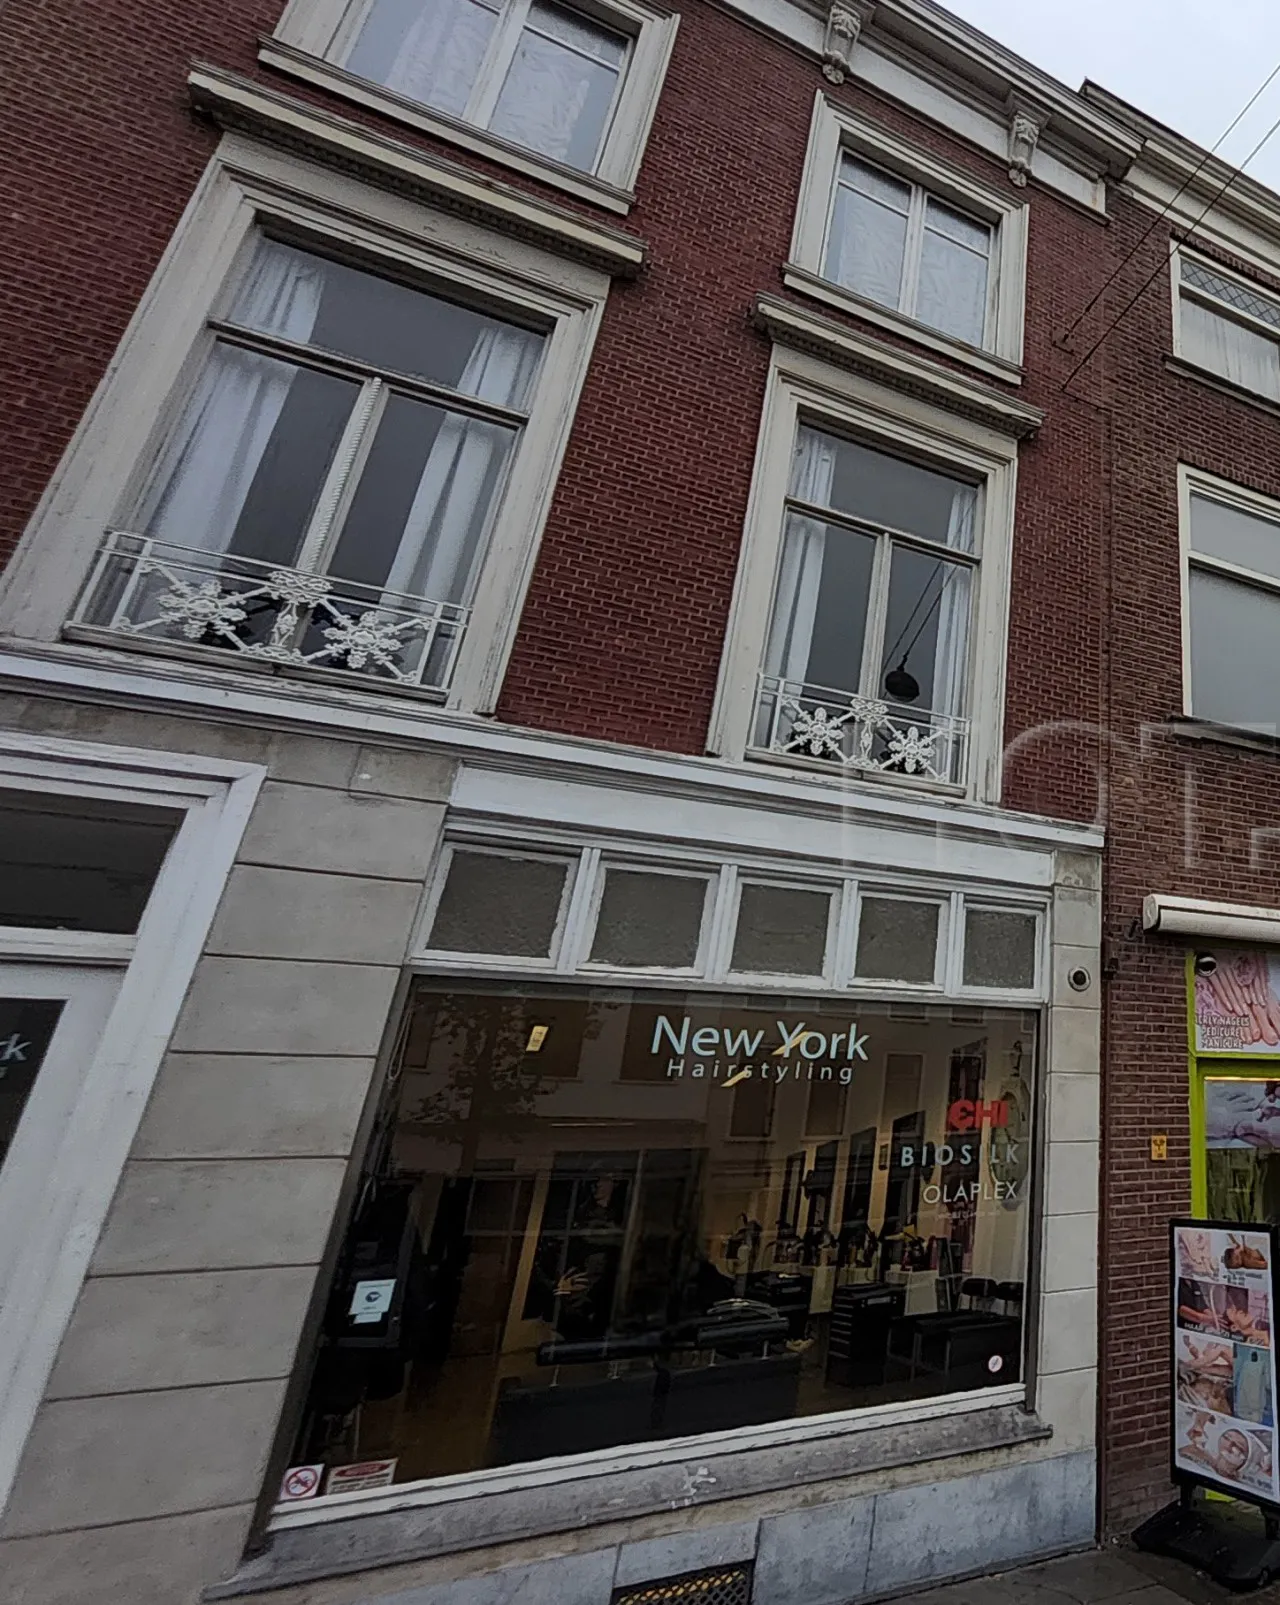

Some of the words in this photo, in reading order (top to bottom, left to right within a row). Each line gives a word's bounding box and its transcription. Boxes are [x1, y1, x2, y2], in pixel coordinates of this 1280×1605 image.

[1202, 1026, 1240, 1037] PEDICURE
[1219, 1016, 1250, 1027] NAGELS
[651, 1015, 765, 1057] New
[776, 1020, 870, 1061] York
[1202, 1037, 1244, 1048] MANICURE
[667, 1058, 853, 1085] Hairstyling
[948, 1099, 1009, 1132] CHI
[901, 1144, 1019, 1167] BIOSILK
[922, 1181, 1018, 1204] OLAPLEX
